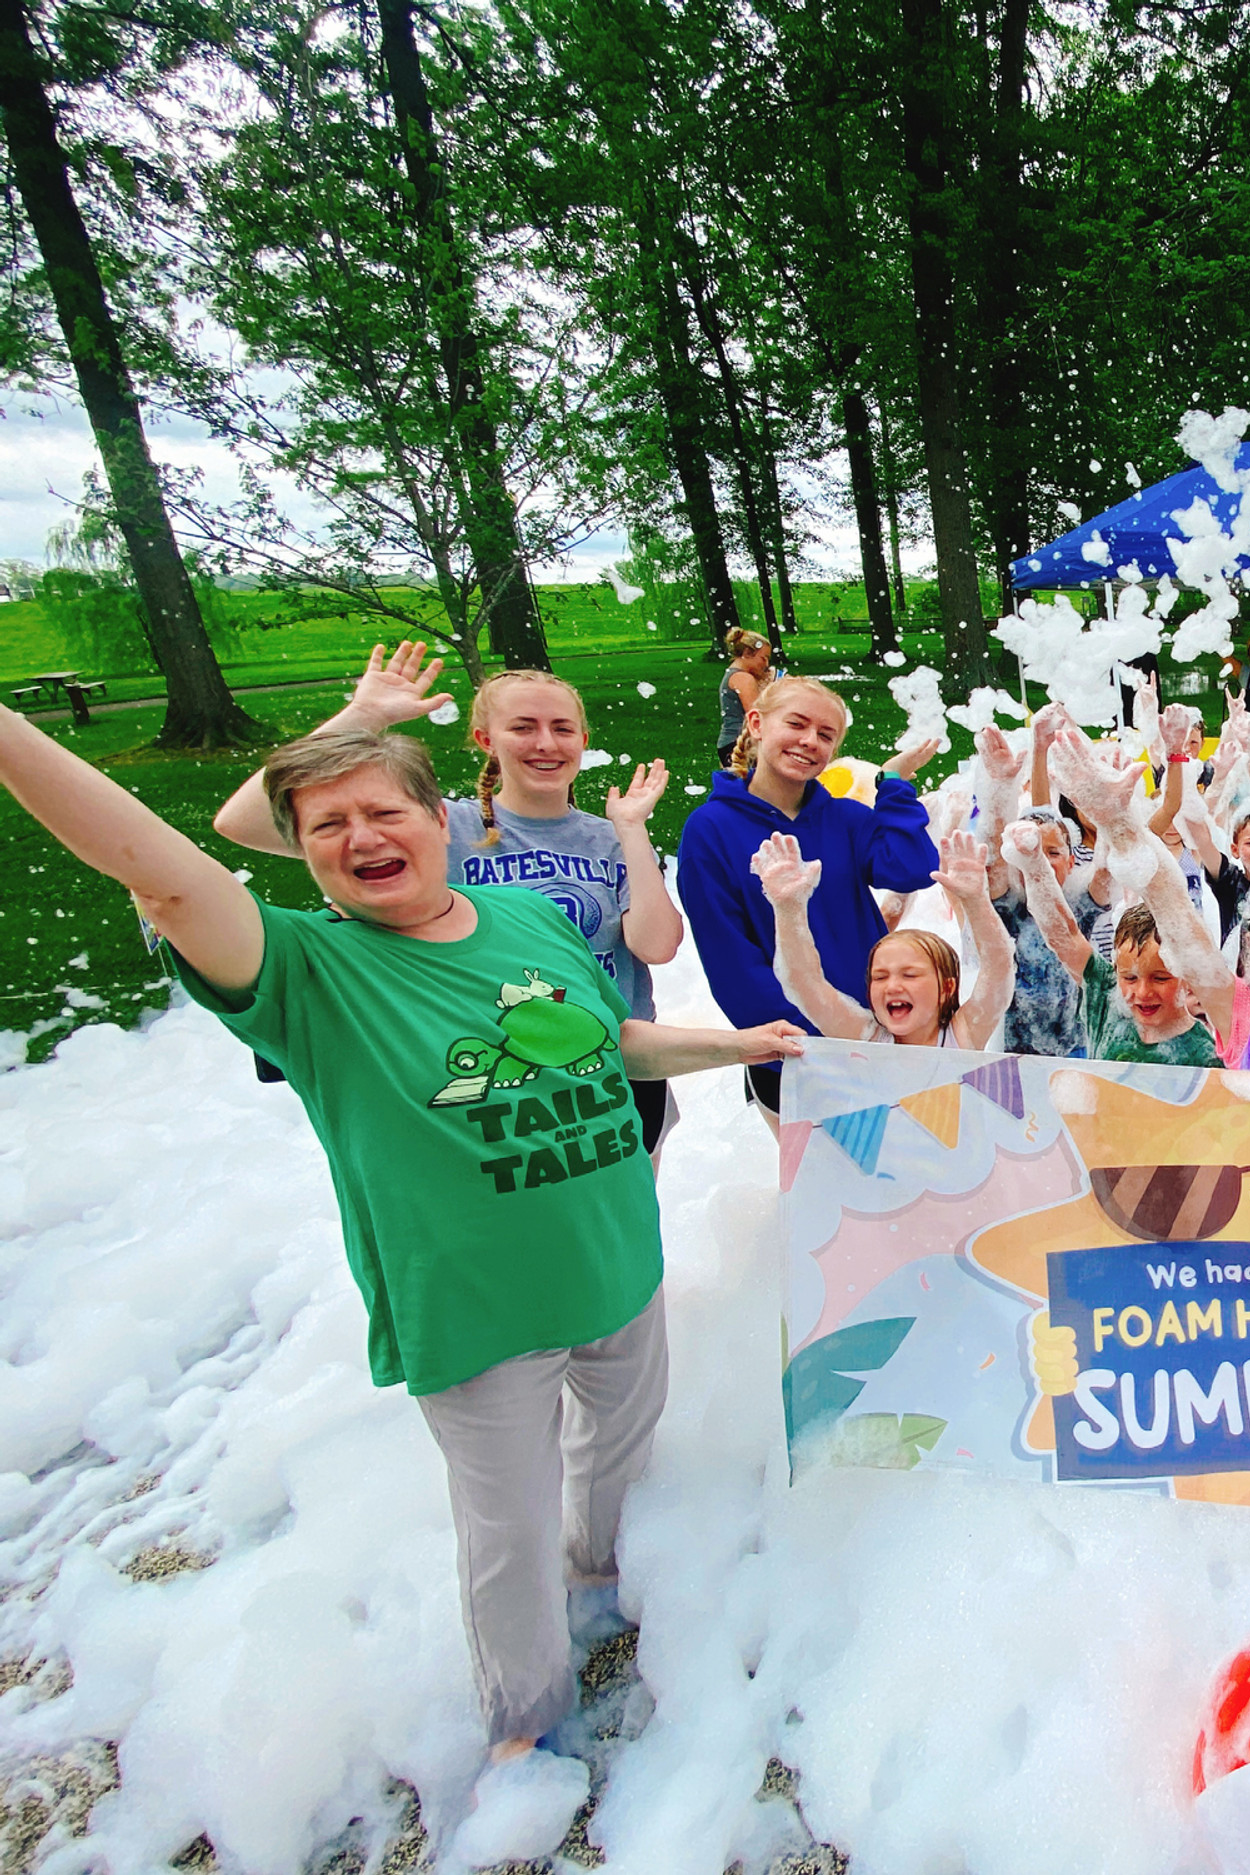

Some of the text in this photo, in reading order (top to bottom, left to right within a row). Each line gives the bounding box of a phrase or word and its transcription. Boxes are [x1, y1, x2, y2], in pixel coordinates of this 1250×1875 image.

[467, 1072, 628, 1143] TAILS
[554, 1125, 588, 1143] AND
[480, 1119, 639, 1194] TALES
[1146, 1261, 1197, 1289] We
[1093, 1298, 1223, 1352] FOAM
